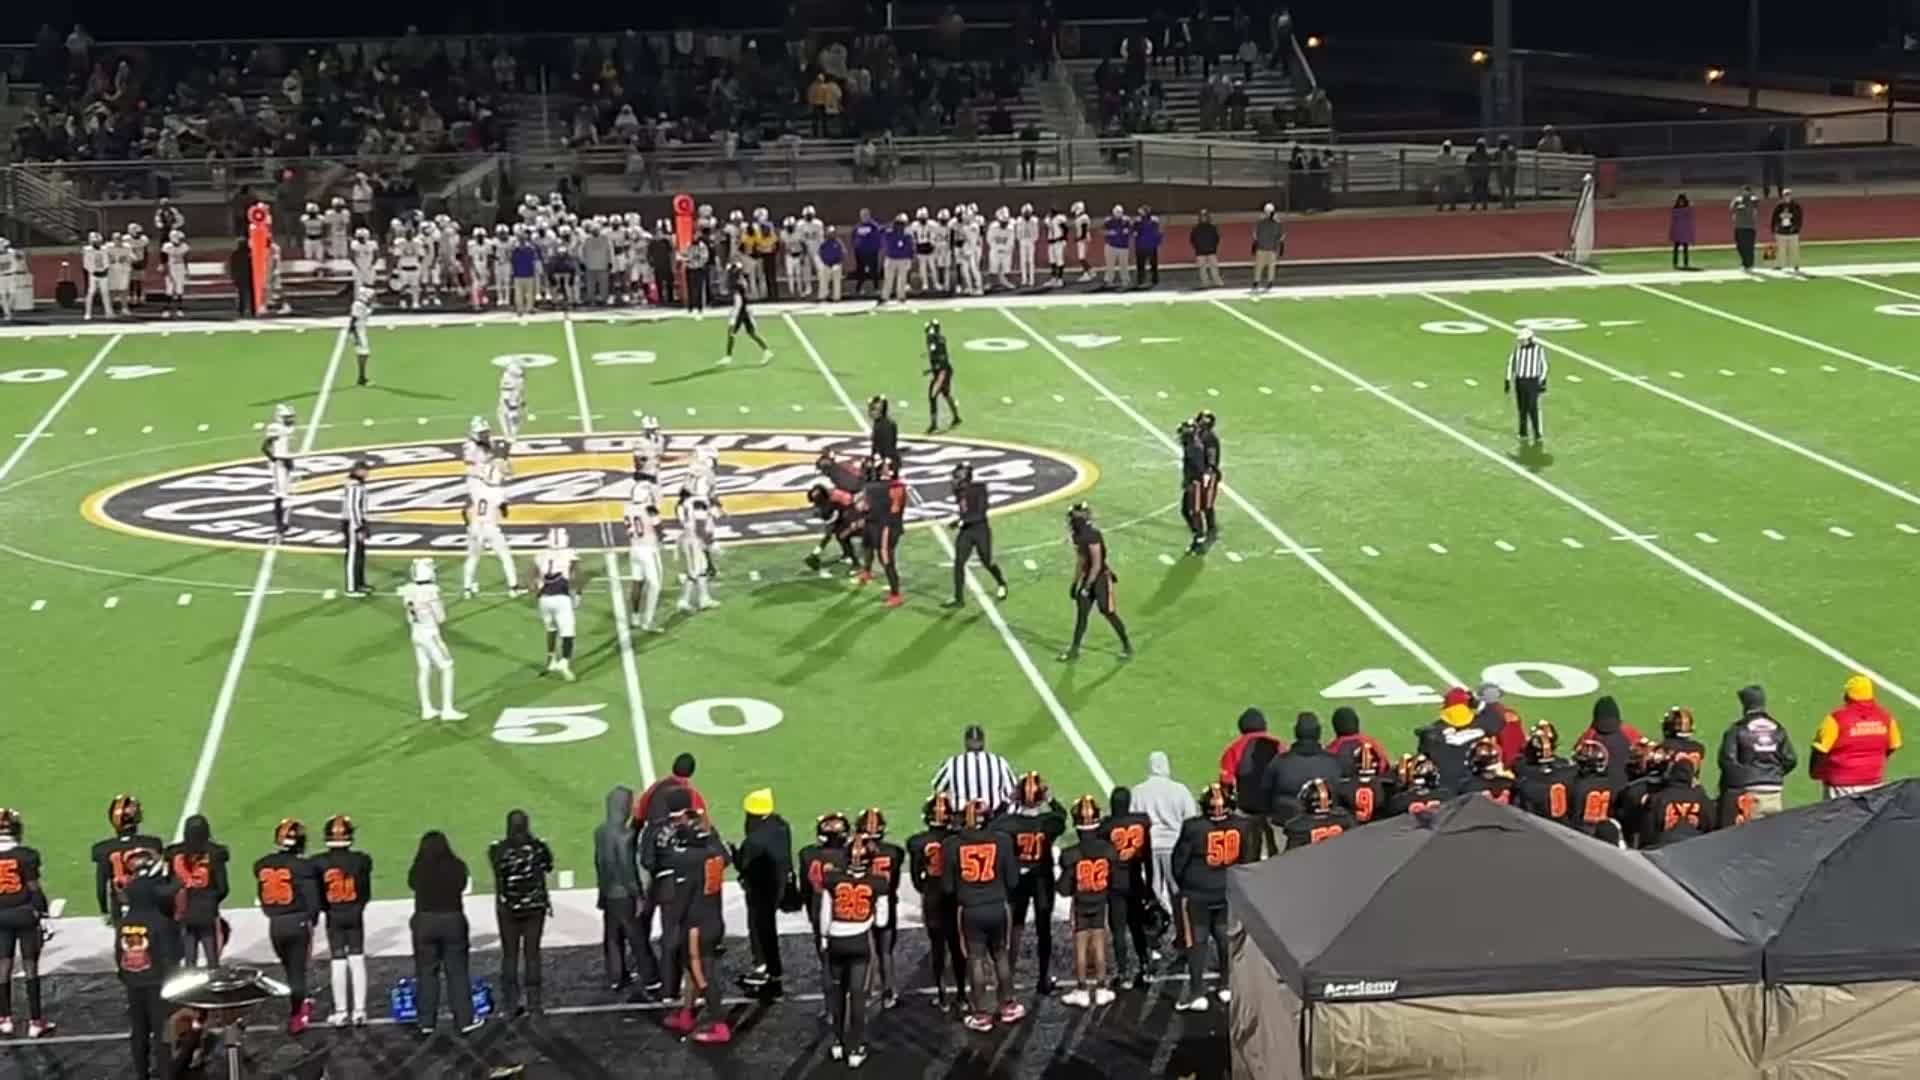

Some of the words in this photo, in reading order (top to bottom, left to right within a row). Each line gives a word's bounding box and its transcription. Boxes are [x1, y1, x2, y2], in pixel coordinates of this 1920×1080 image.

[1355, 786, 1375, 821] 9
[959, 843, 998, 881] 57
[1324, 980, 1398, 997] Academy
